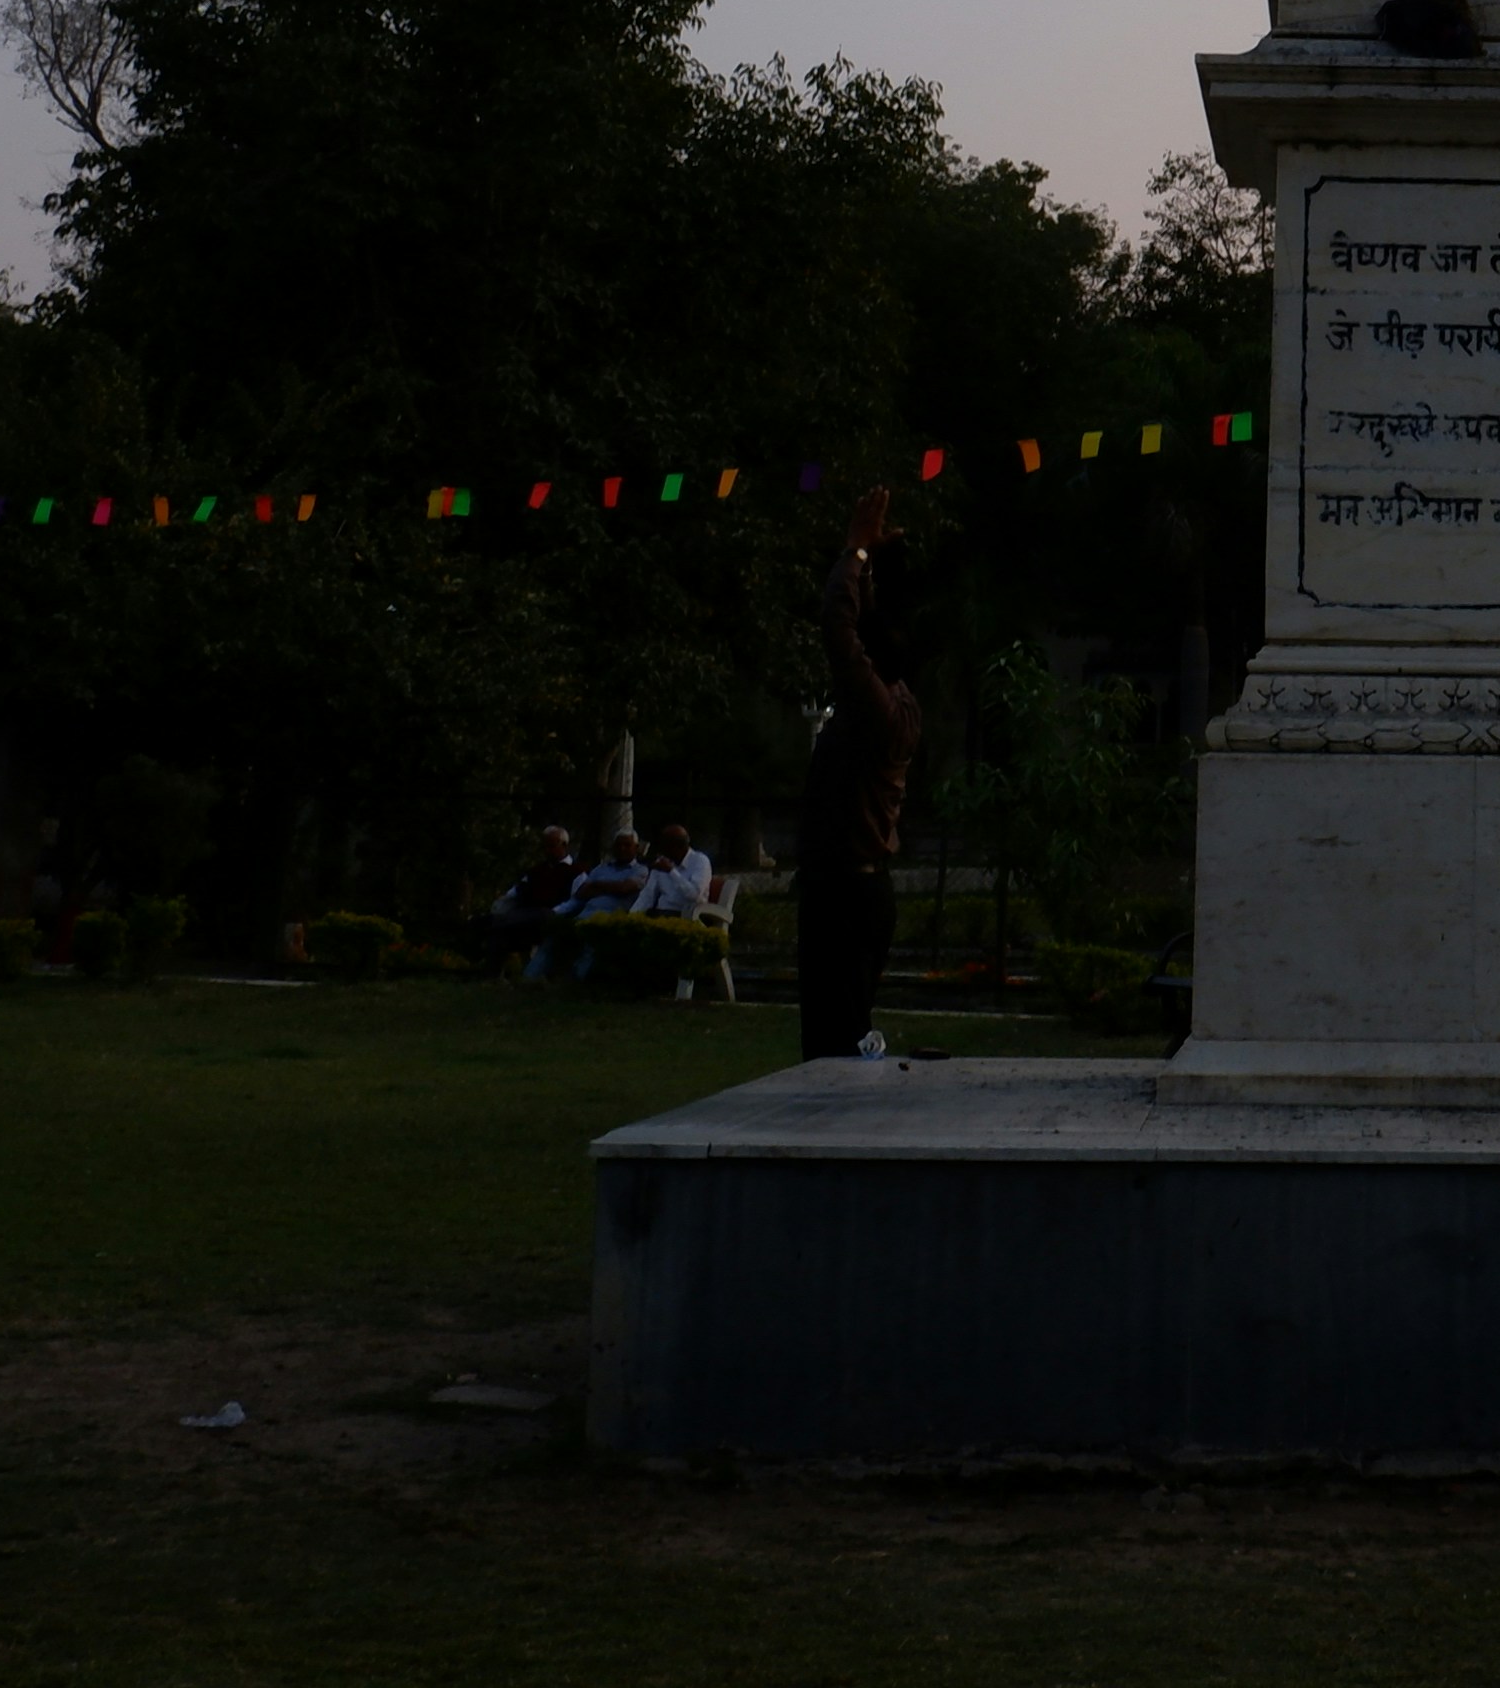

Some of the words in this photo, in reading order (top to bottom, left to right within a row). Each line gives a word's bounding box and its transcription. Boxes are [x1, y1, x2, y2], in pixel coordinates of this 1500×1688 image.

[1330, 230, 1426, 273] वैष्णव
[1430, 244, 1482, 273] जन
[1325, 309, 1360, 352] जे
[1367, 309, 1427, 359] पीड़
